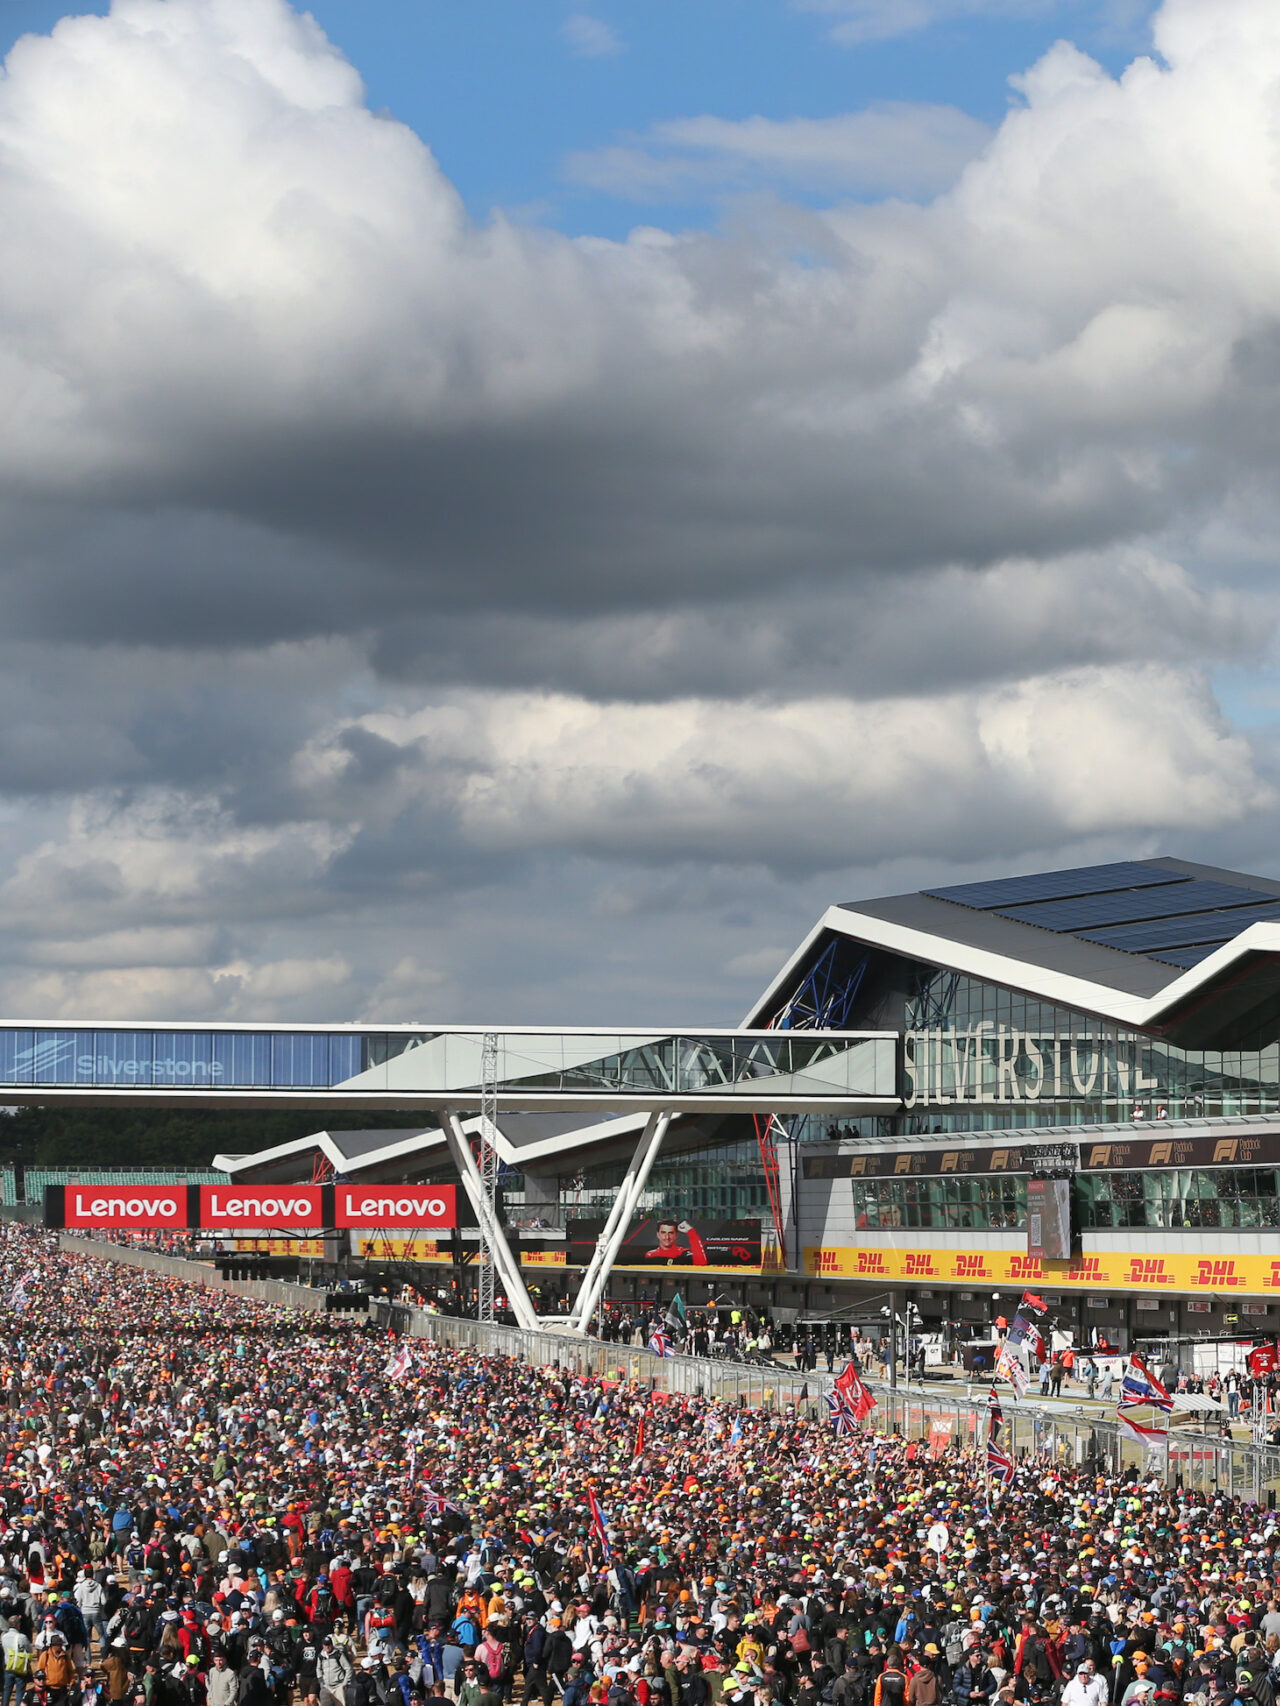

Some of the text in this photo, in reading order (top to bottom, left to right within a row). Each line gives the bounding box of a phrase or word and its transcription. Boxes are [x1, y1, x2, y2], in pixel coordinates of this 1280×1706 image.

[77, 1055, 224, 1076] Silverstone
[904, 1020, 1157, 1108] SILVERSTONE
[75, 1195, 177, 1217] Lenovo
[211, 1194, 312, 1217] Lenovo
[346, 1194, 446, 1217] Lenovo
[858, 1253, 884, 1273] DHL
[906, 1254, 933, 1275] DHL
[956, 1255, 986, 1277] DHL
[1010, 1256, 1042, 1278] DHL
[1069, 1258, 1102, 1281] DHL
[1130, 1259, 1168, 1283] DHL
[1198, 1261, 1239, 1286] DHL
